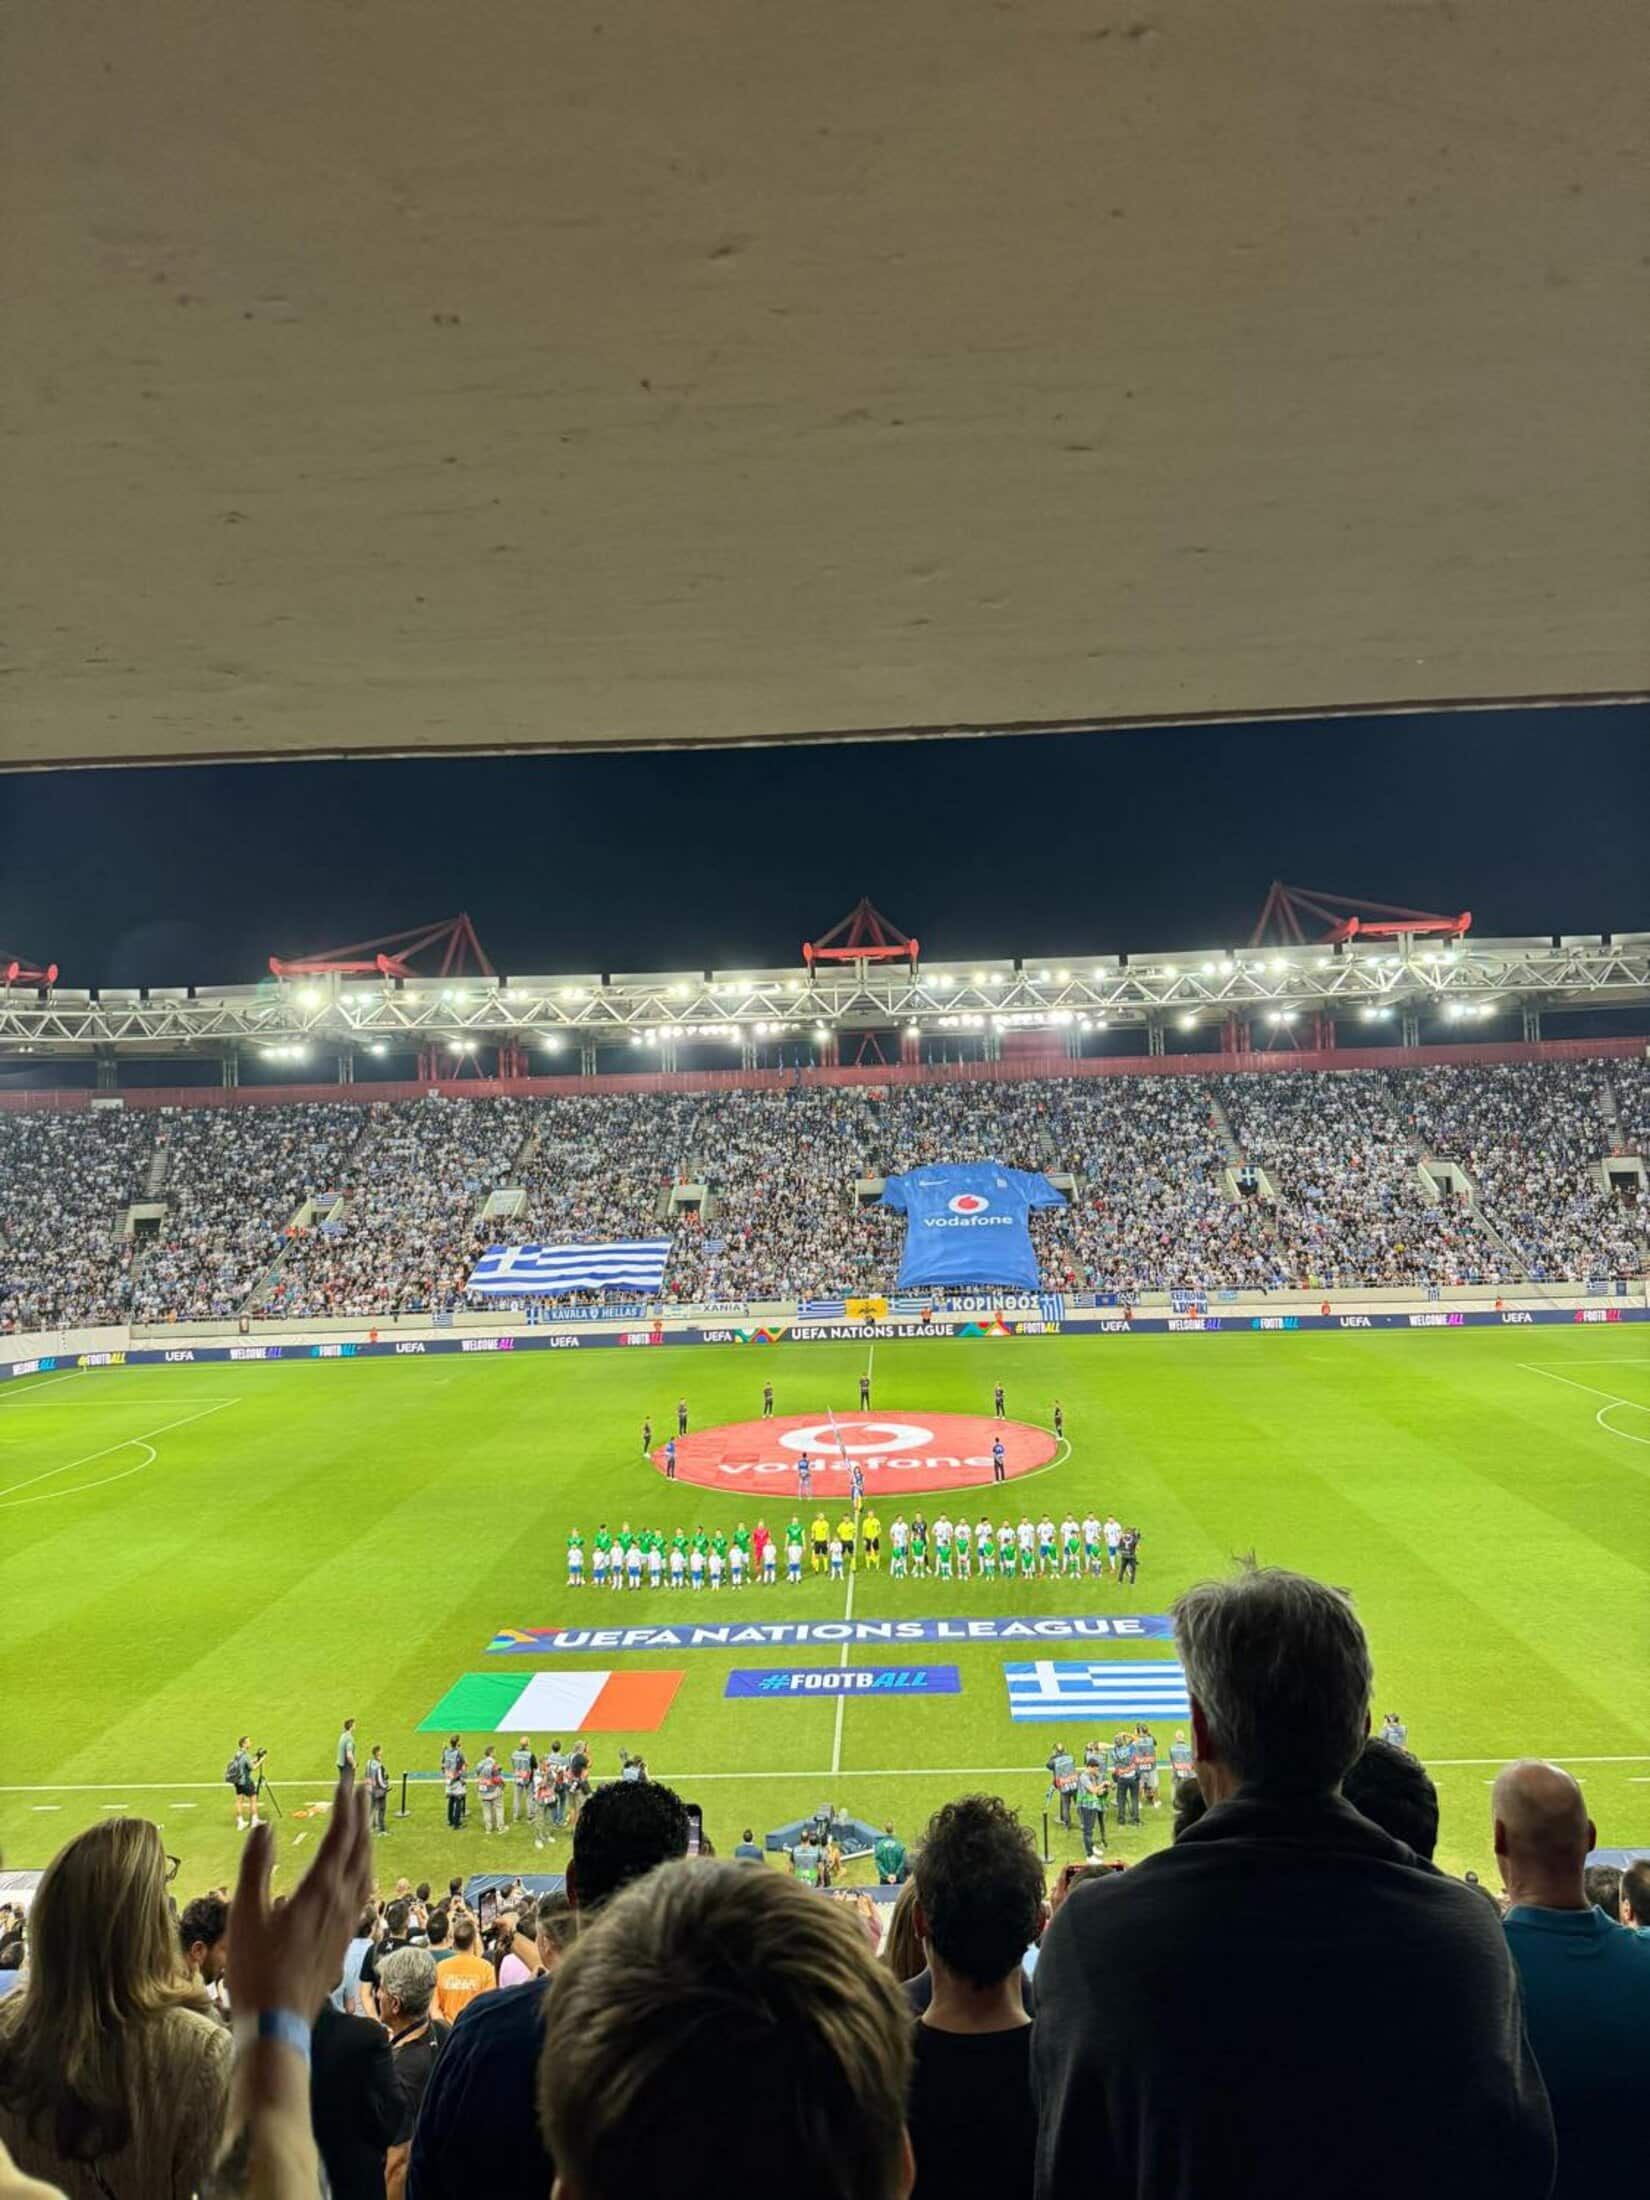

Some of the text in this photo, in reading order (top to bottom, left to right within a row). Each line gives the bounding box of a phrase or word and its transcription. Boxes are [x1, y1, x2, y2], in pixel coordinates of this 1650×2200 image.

[923, 1215, 1014, 1227] vodafone
[551, 1306, 638, 1320] KAVALA HELLAS
[1501, 1311, 1533, 1323] UEFA
[1100, 1321, 1131, 1332] UEFA
[1340, 1316, 1372, 1327] UEFA
[703, 1330, 733, 1342] UEFA
[791, 1324, 955, 1340] UEFA NATIONS LEAGUE
[395, 1342, 426, 1353] UEFA
[550, 1336, 580, 1348] UEFA
[165, 1350, 195, 1361] UEFA
[553, 1618, 1145, 1647] UEFA NATIONS LEAGUE
[758, 1671, 929, 1690] #FOOTBALL
